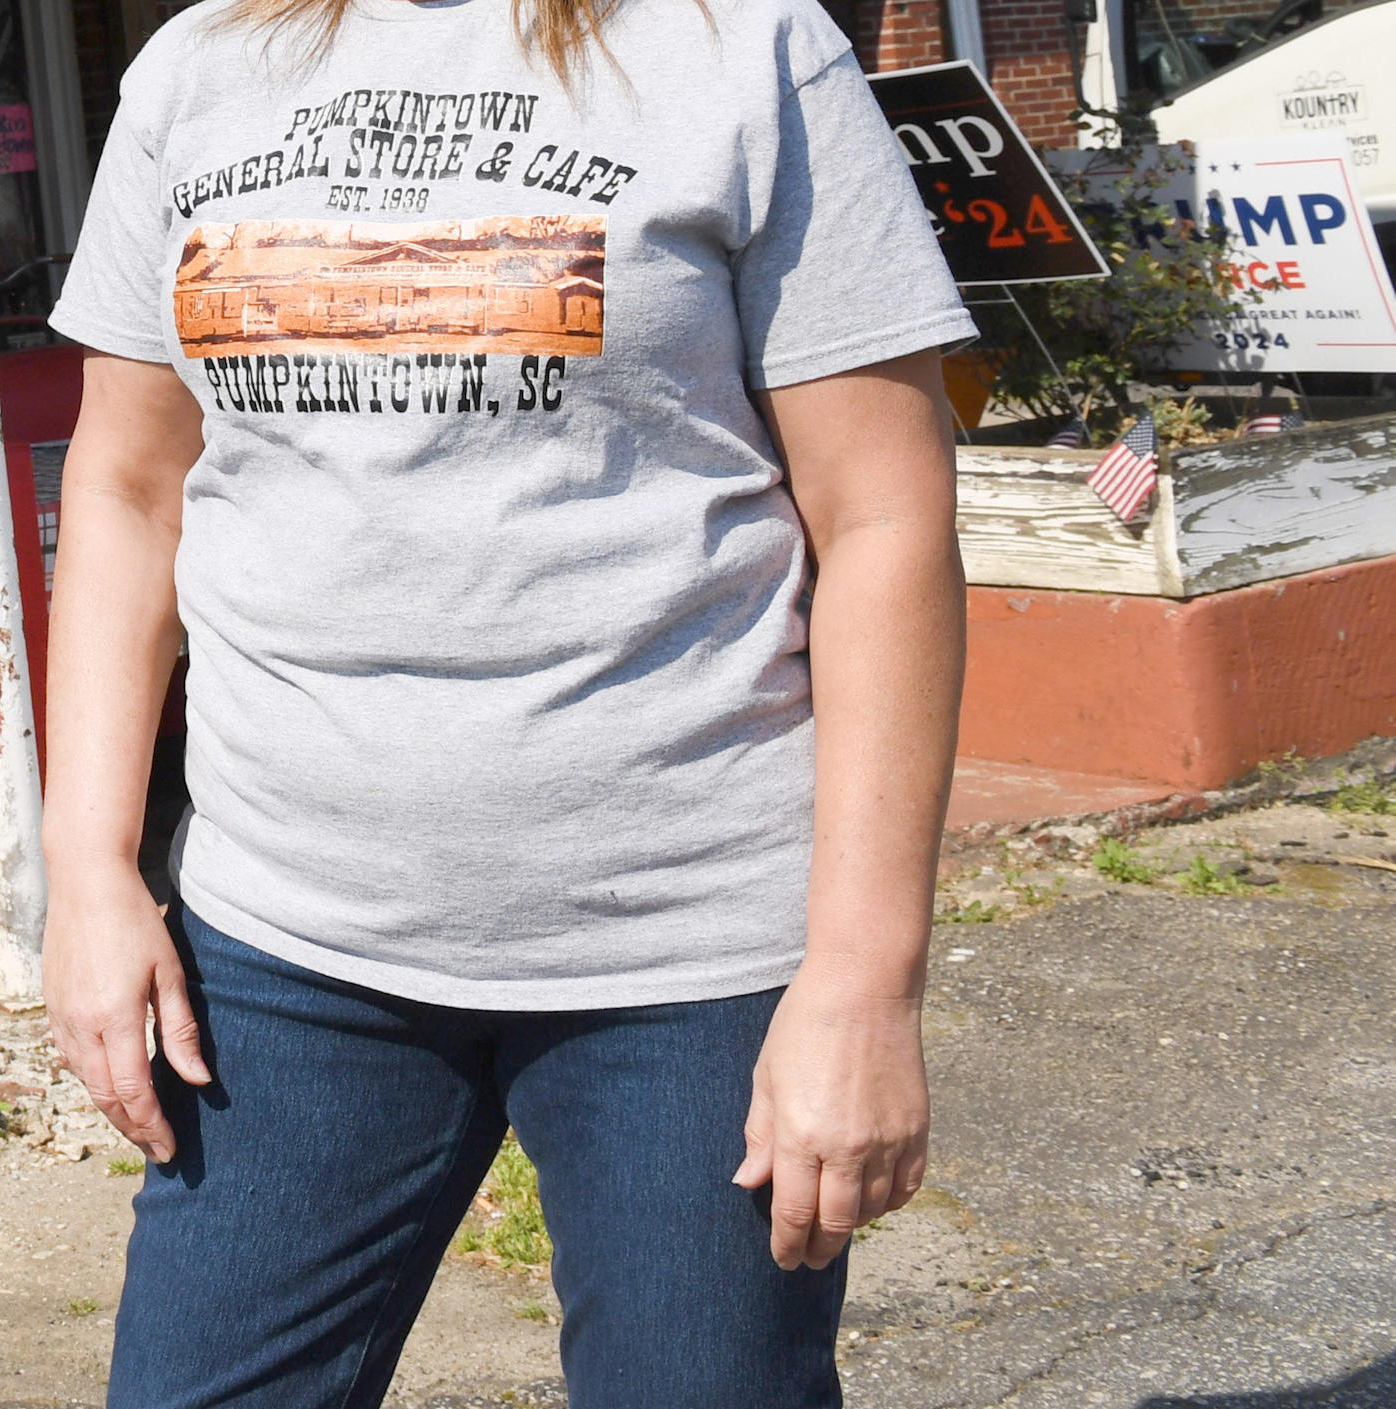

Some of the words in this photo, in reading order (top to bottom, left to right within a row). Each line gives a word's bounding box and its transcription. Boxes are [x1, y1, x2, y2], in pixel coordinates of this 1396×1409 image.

[284, 89, 539, 141] PUMPKINTOWN
[1283, 92, 1359, 120] KOUNTRY
[172, 141, 330, 219] GENERAL
[345, 129, 473, 182] STORE
[475, 142, 515, 183] &
[521, 144, 638, 206] CAFE
[325, 184, 371, 212] EST.
[380, 187, 430, 214] 1938
[1249, 310, 1298, 320] GREAT
[1306, 309, 1361, 320] AGAIN!
[1215, 333, 1290, 349] 2024
[205, 354, 500, 417] PUMPKINTOWN,
[518, 356, 566, 412] SC
